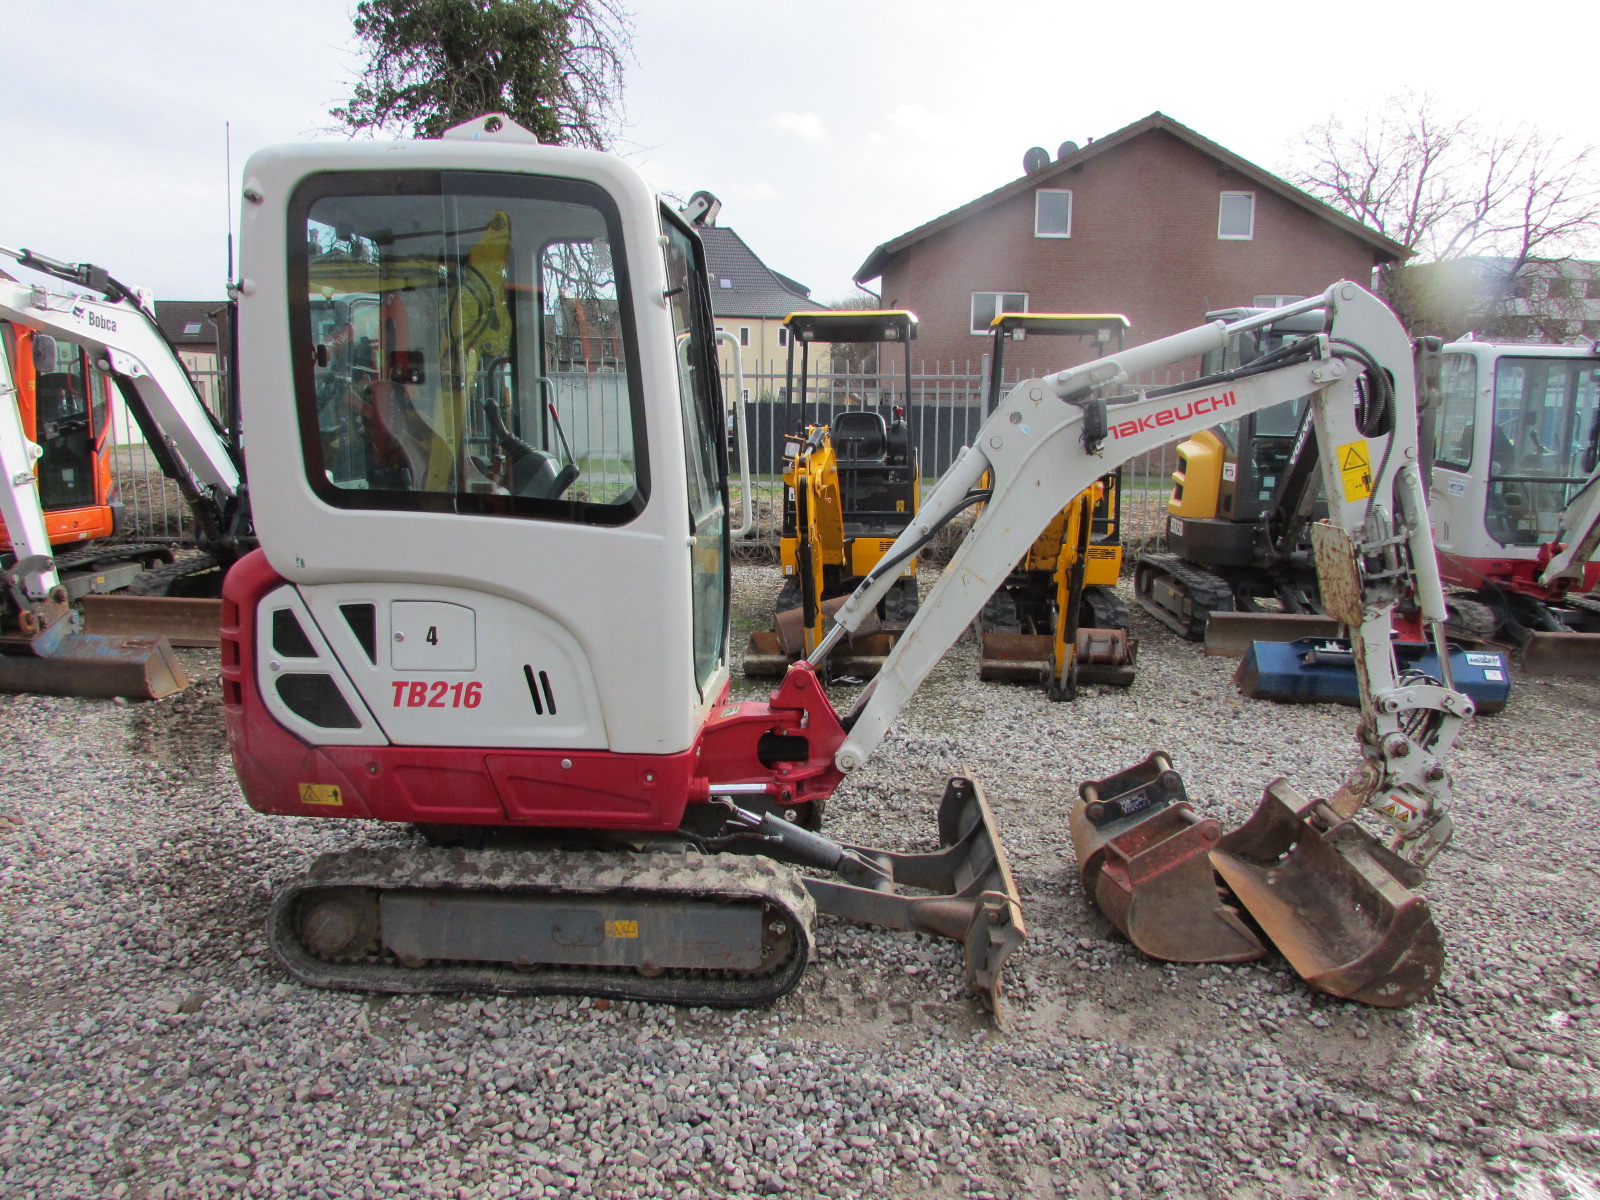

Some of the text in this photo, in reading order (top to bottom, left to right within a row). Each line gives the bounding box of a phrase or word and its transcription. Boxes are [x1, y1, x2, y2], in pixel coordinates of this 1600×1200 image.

[1289, 407, 1314, 465] VOLVO
[426, 626, 438, 645] 4
[391, 681, 483, 708] TB216
